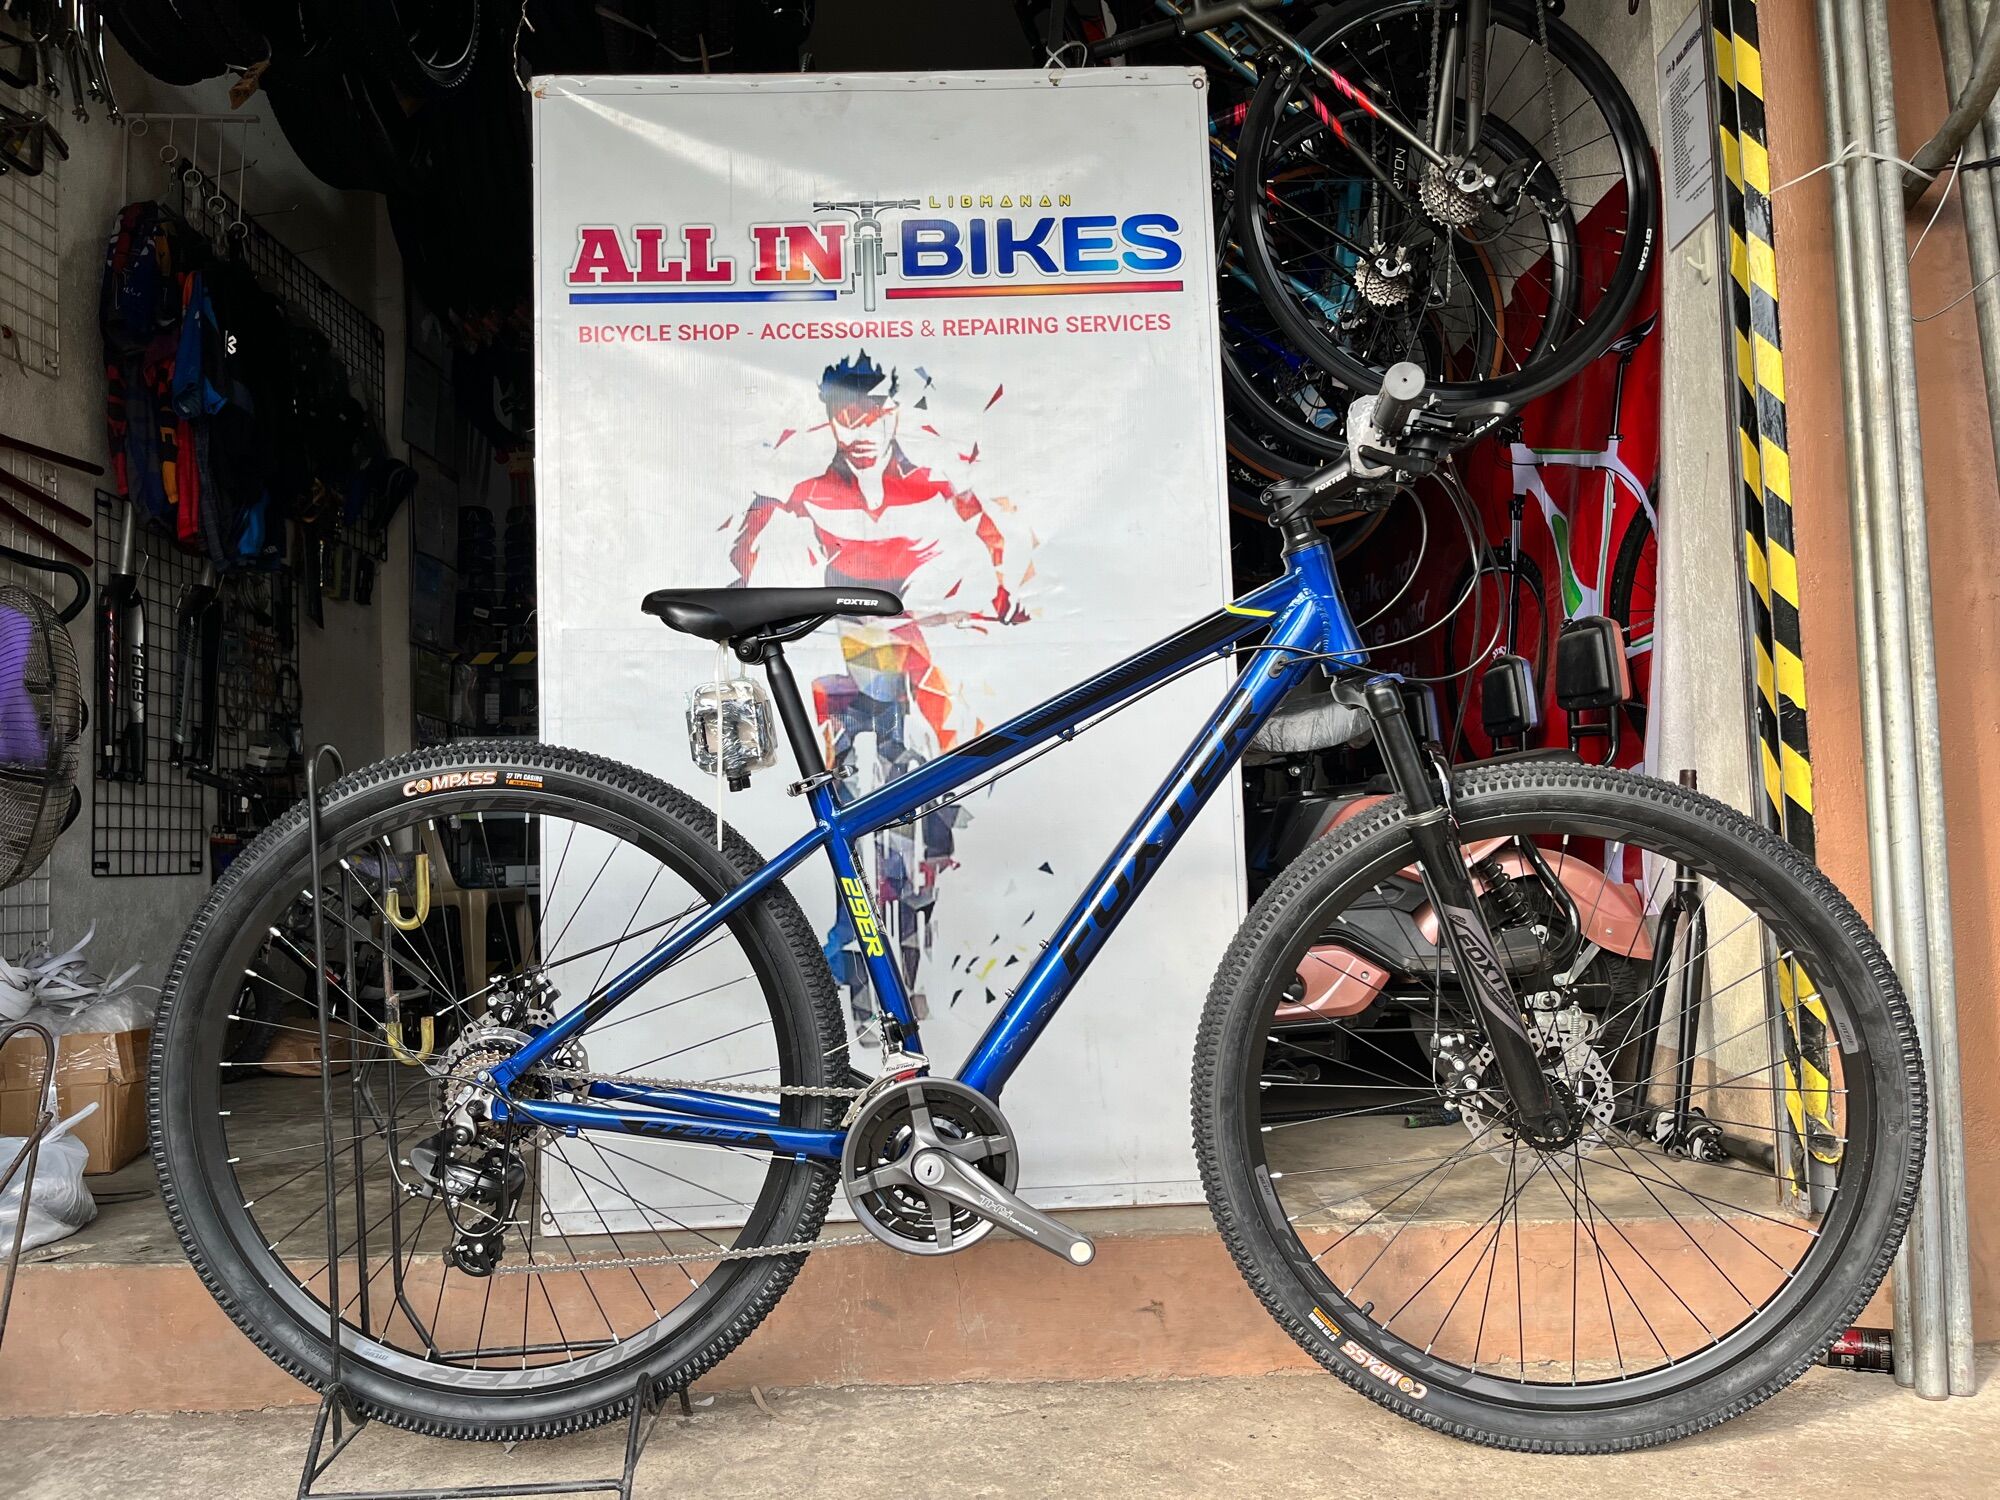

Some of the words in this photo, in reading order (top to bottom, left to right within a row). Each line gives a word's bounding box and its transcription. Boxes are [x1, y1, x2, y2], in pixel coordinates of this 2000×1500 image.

[1471, 42, 1484, 104] TRITON
[1393, 147, 1406, 190] RITON
[567, 227, 734, 284] ALL
[752, 223, 847, 282] IN
[900, 213, 1183, 277] BIKES
[578, 325, 672, 343] BICYCLE
[677, 323, 740, 341] SHOP
[760, 319, 914, 340] ACCESSORIES
[920, 319, 936, 337] &
[942, 316, 1059, 337] REPAIRING
[1066, 313, 1172, 333] SERVICES
[836, 597, 879, 607] FOXTER
[402, 770, 498, 797] COMPASS
[1058, 687, 1258, 977] FOXTER
[841, 877, 884, 957] 29ER
[1339, 1340, 1428, 1400] COMPASS
